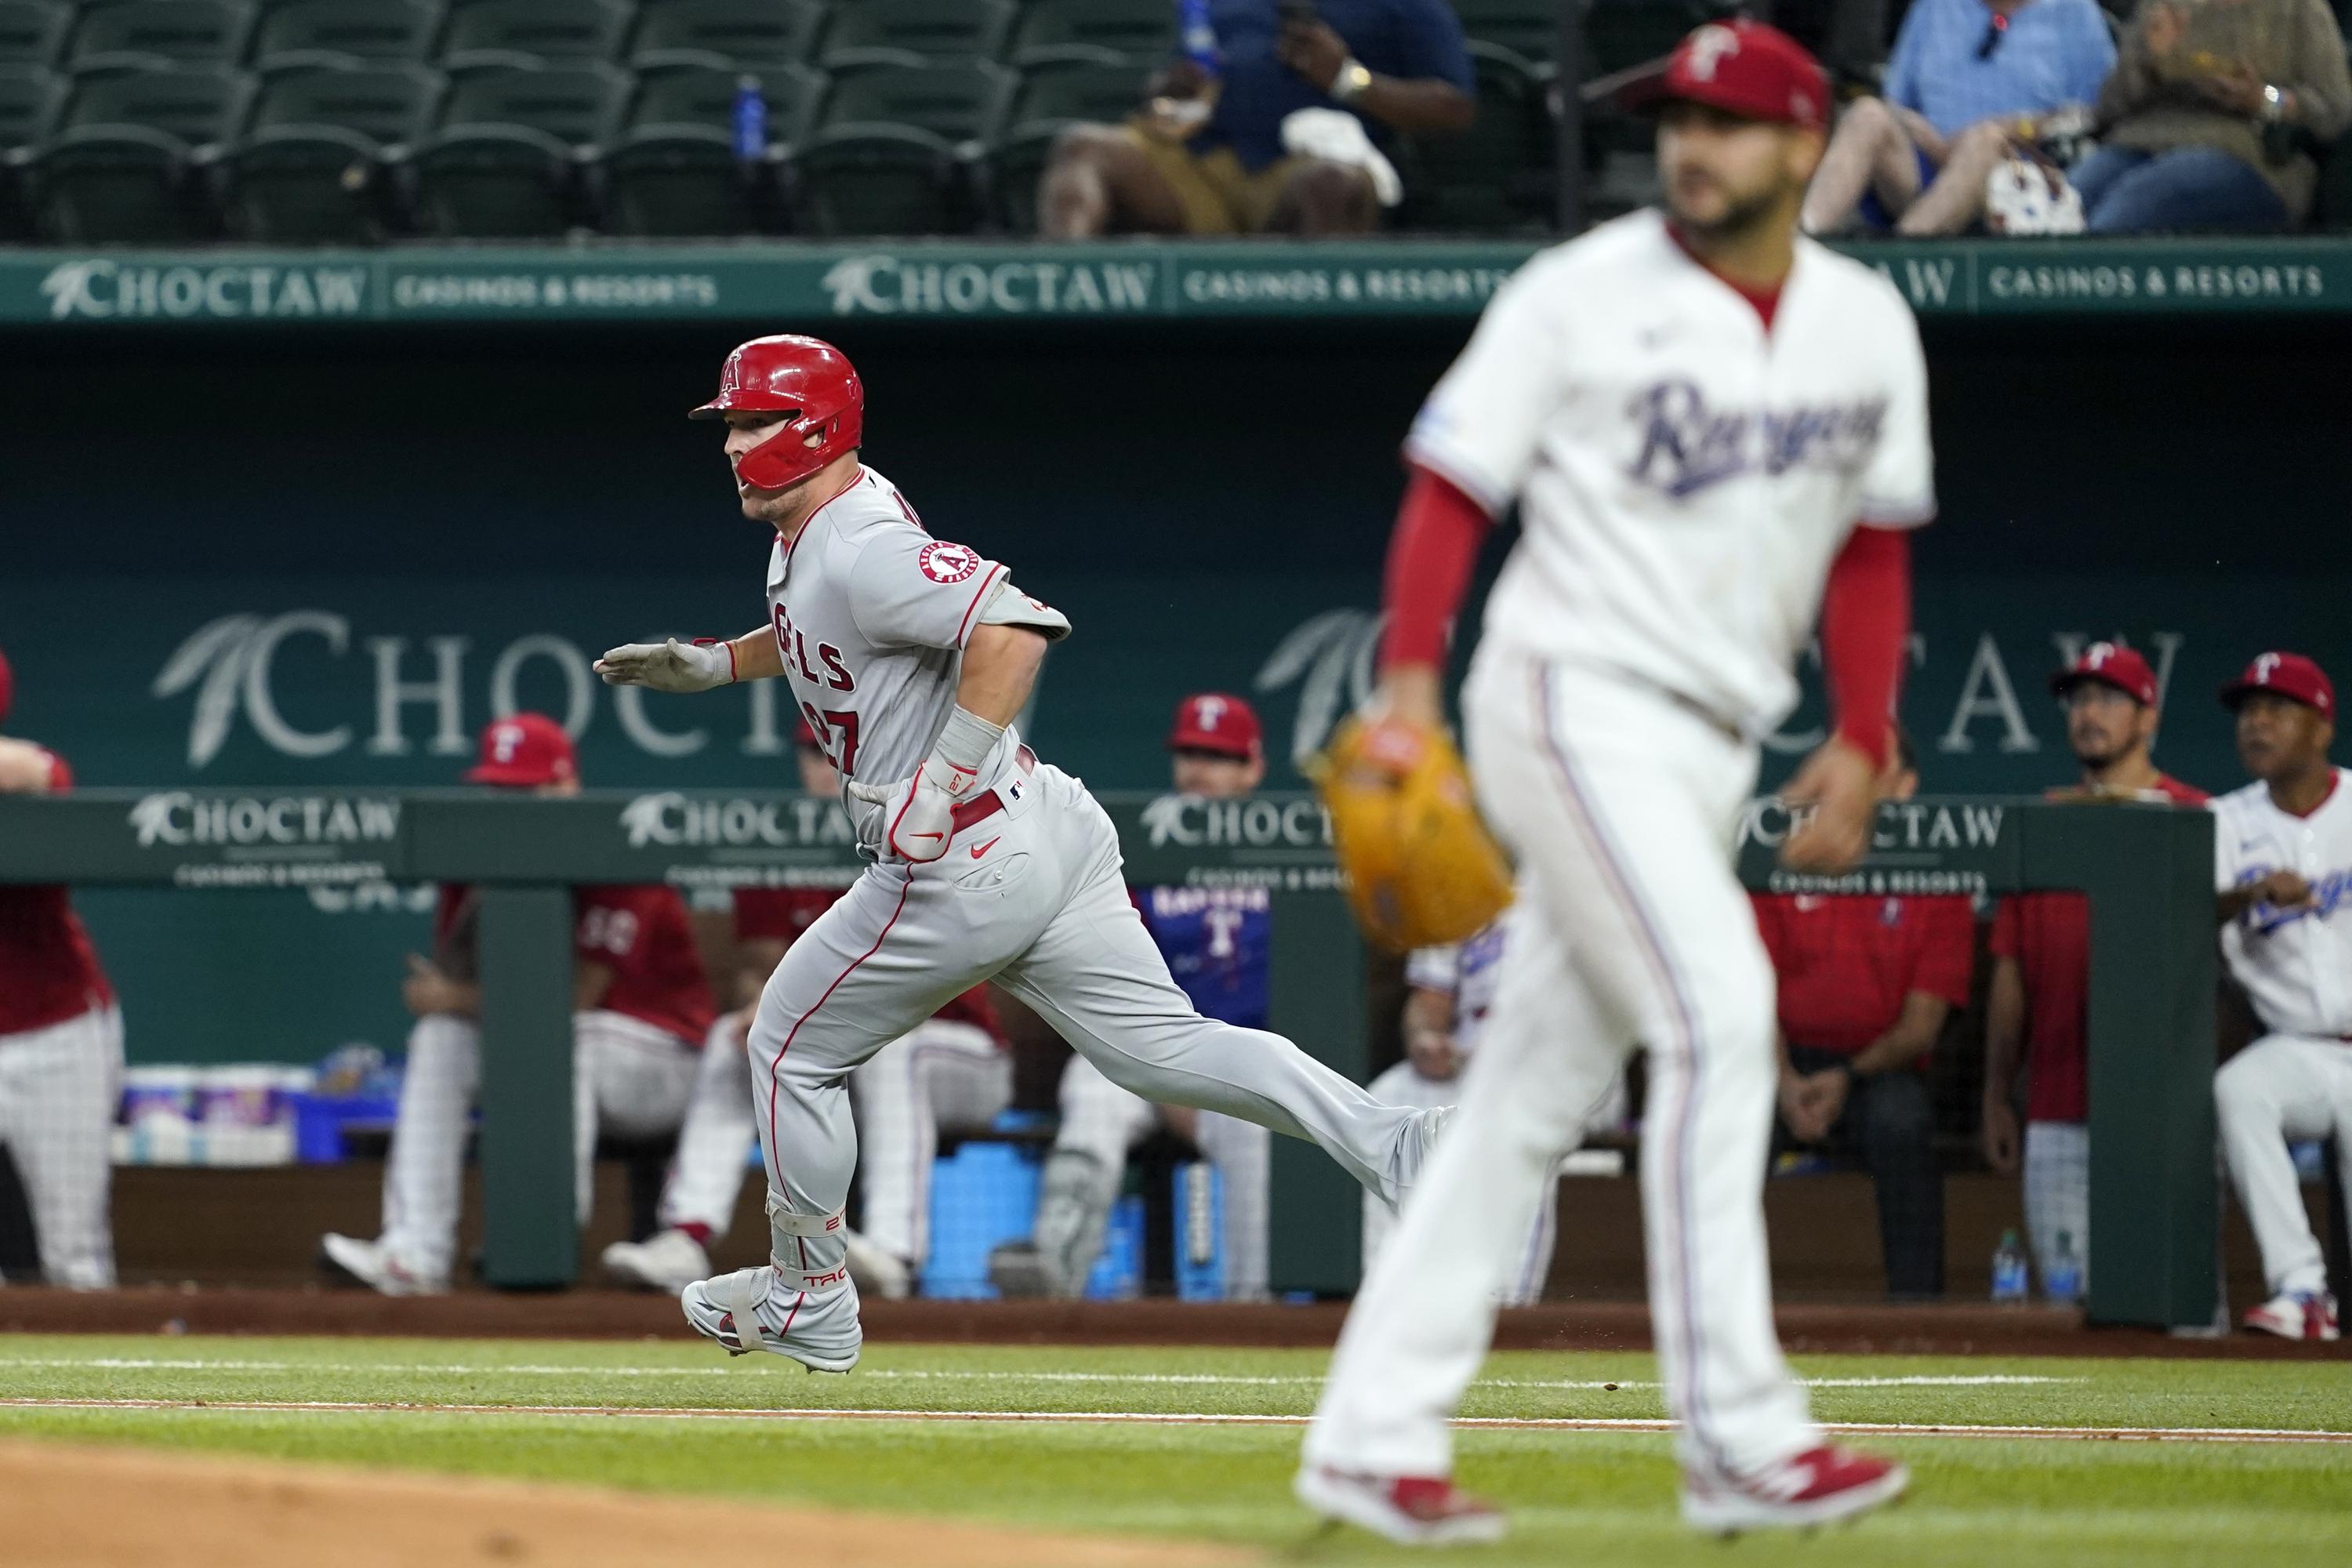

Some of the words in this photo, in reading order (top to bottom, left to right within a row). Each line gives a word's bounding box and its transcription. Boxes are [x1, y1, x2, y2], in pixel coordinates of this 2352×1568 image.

[77, 259, 367, 316] CHOCTAW
[861, 255, 1156, 312] CHOCTAW
[1988, 265, 2136, 298] CASINOS
[2146, 266, 2166, 297] &
[2175, 265, 2323, 298] RESORTS
[774, 601, 857, 694] GELS
[949, 773, 962, 792] 27
[163, 792, 401, 844] CHOCTAW
[655, 792, 857, 845] CHOCTA
[1173, 793, 1334, 846] CHOCT
